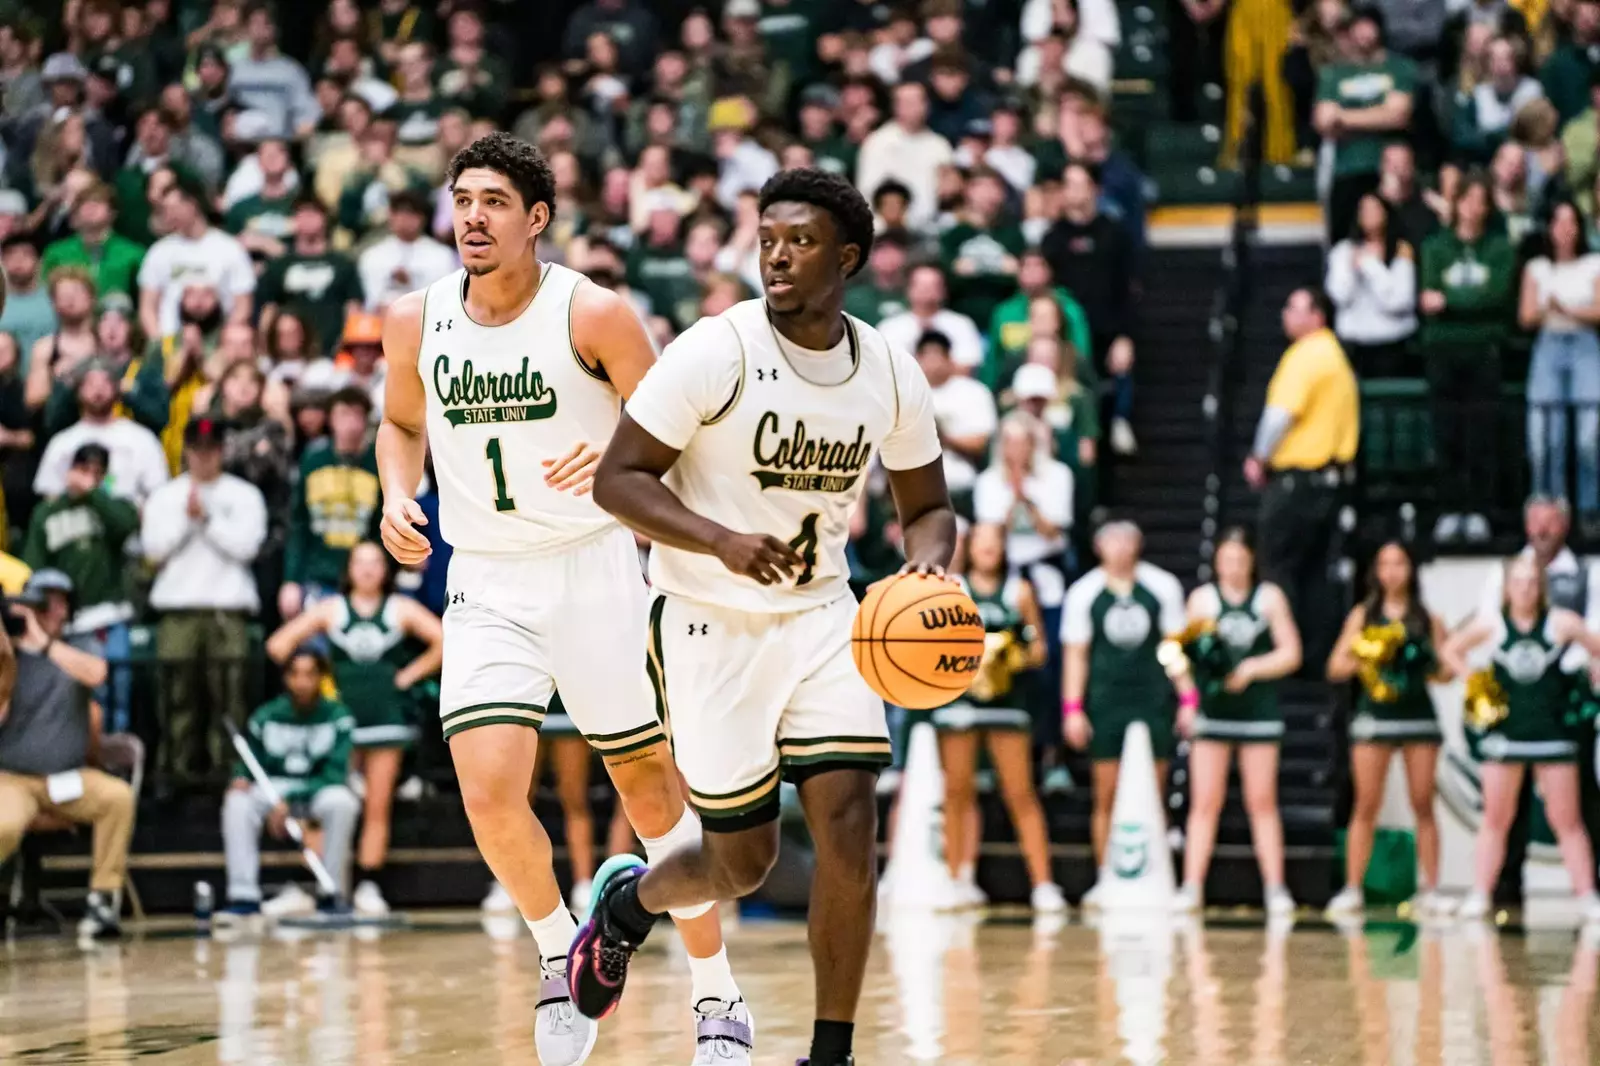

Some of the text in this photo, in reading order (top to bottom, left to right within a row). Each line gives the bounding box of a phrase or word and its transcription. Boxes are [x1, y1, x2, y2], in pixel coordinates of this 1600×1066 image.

[433, 354, 545, 406] Colorado
[463, 406, 528, 424] STATE UNIV
[485, 437, 517, 512] 1
[781, 474, 816, 490] STATE
[787, 512, 820, 587] 4
